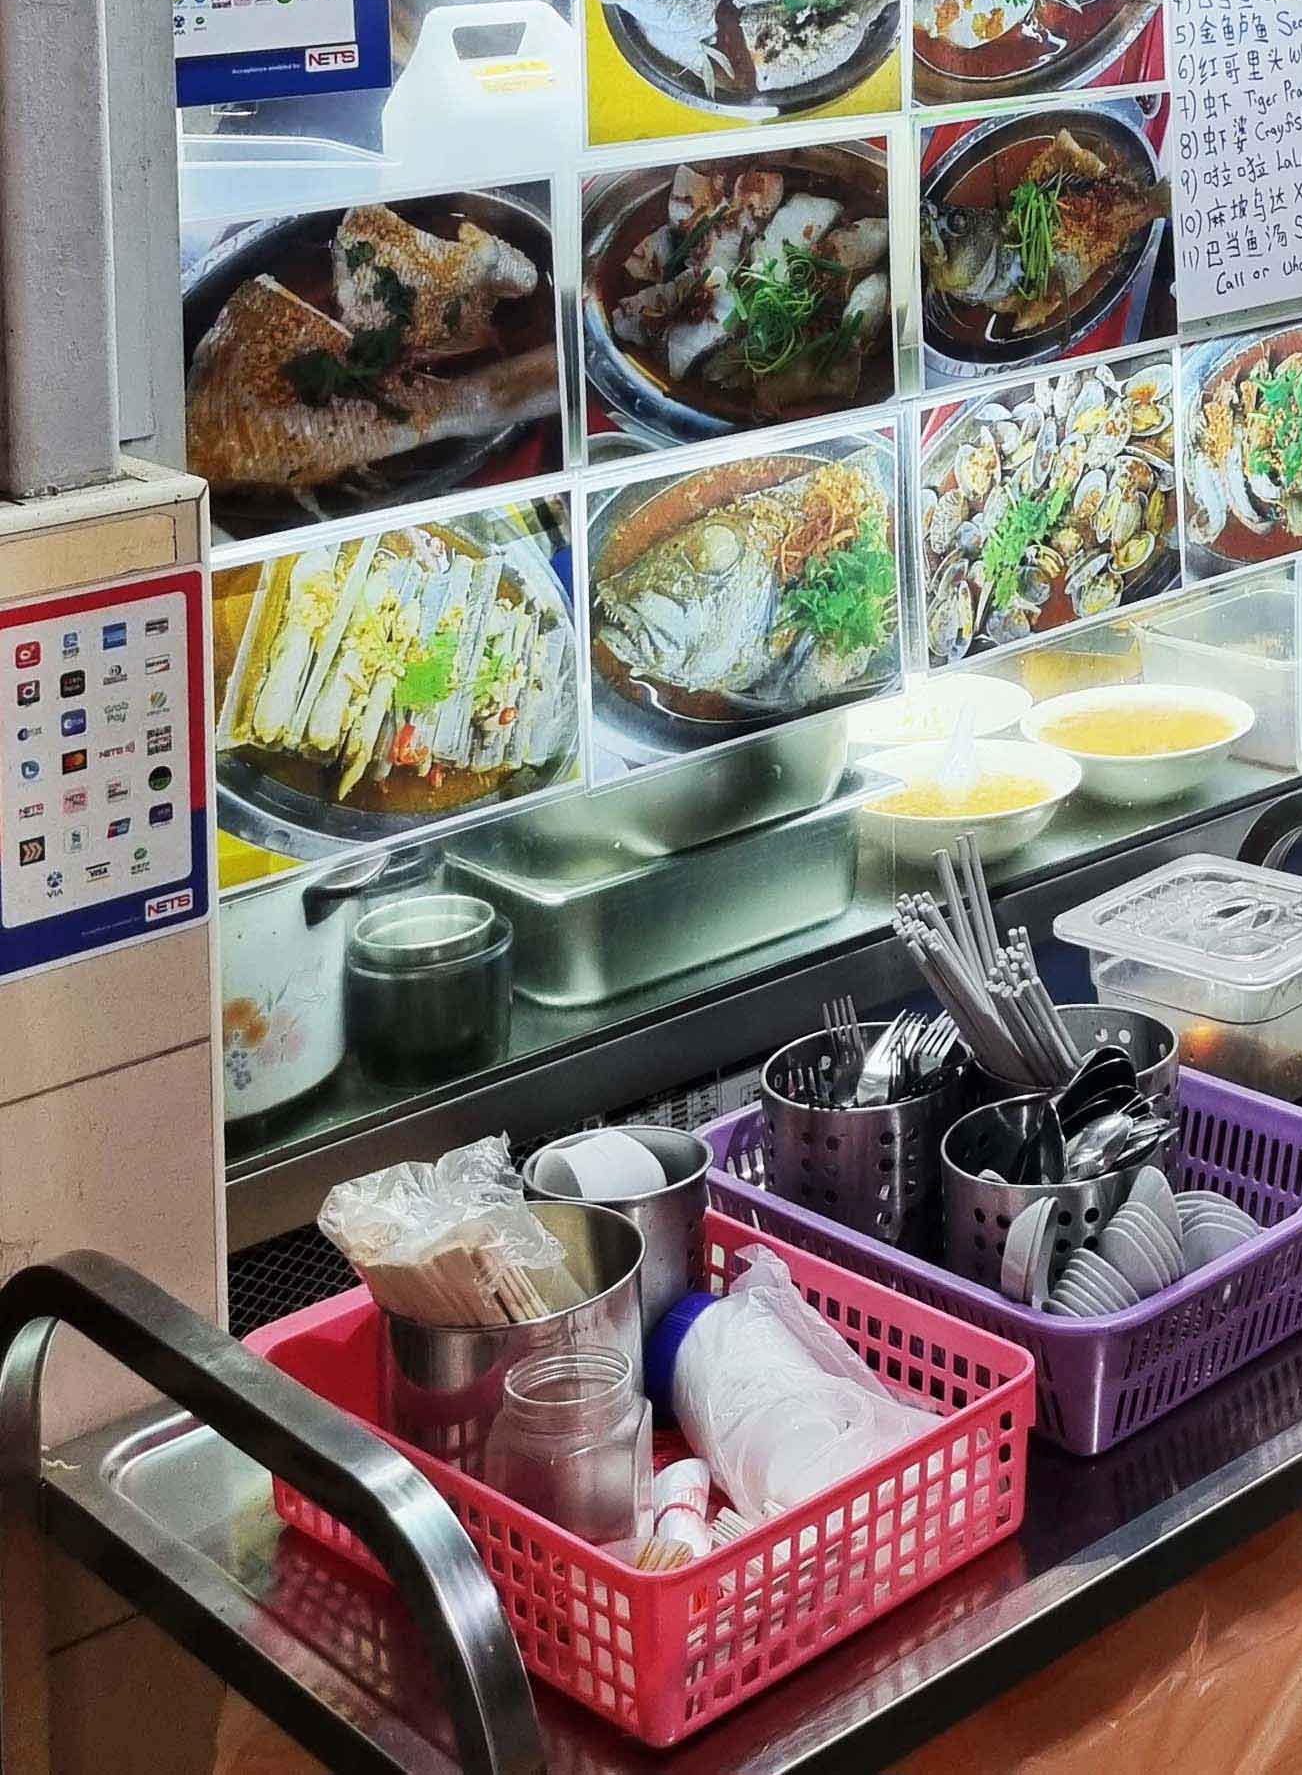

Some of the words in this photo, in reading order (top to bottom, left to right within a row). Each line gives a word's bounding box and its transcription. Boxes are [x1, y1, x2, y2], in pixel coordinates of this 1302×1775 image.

[308, 50, 357, 68] NETS
[1244, 90, 1278, 115] Tiger
[1216, 271, 1245, 295] Call
[1252, 266, 1270, 279] or
[147, 892, 192, 919] NETS
